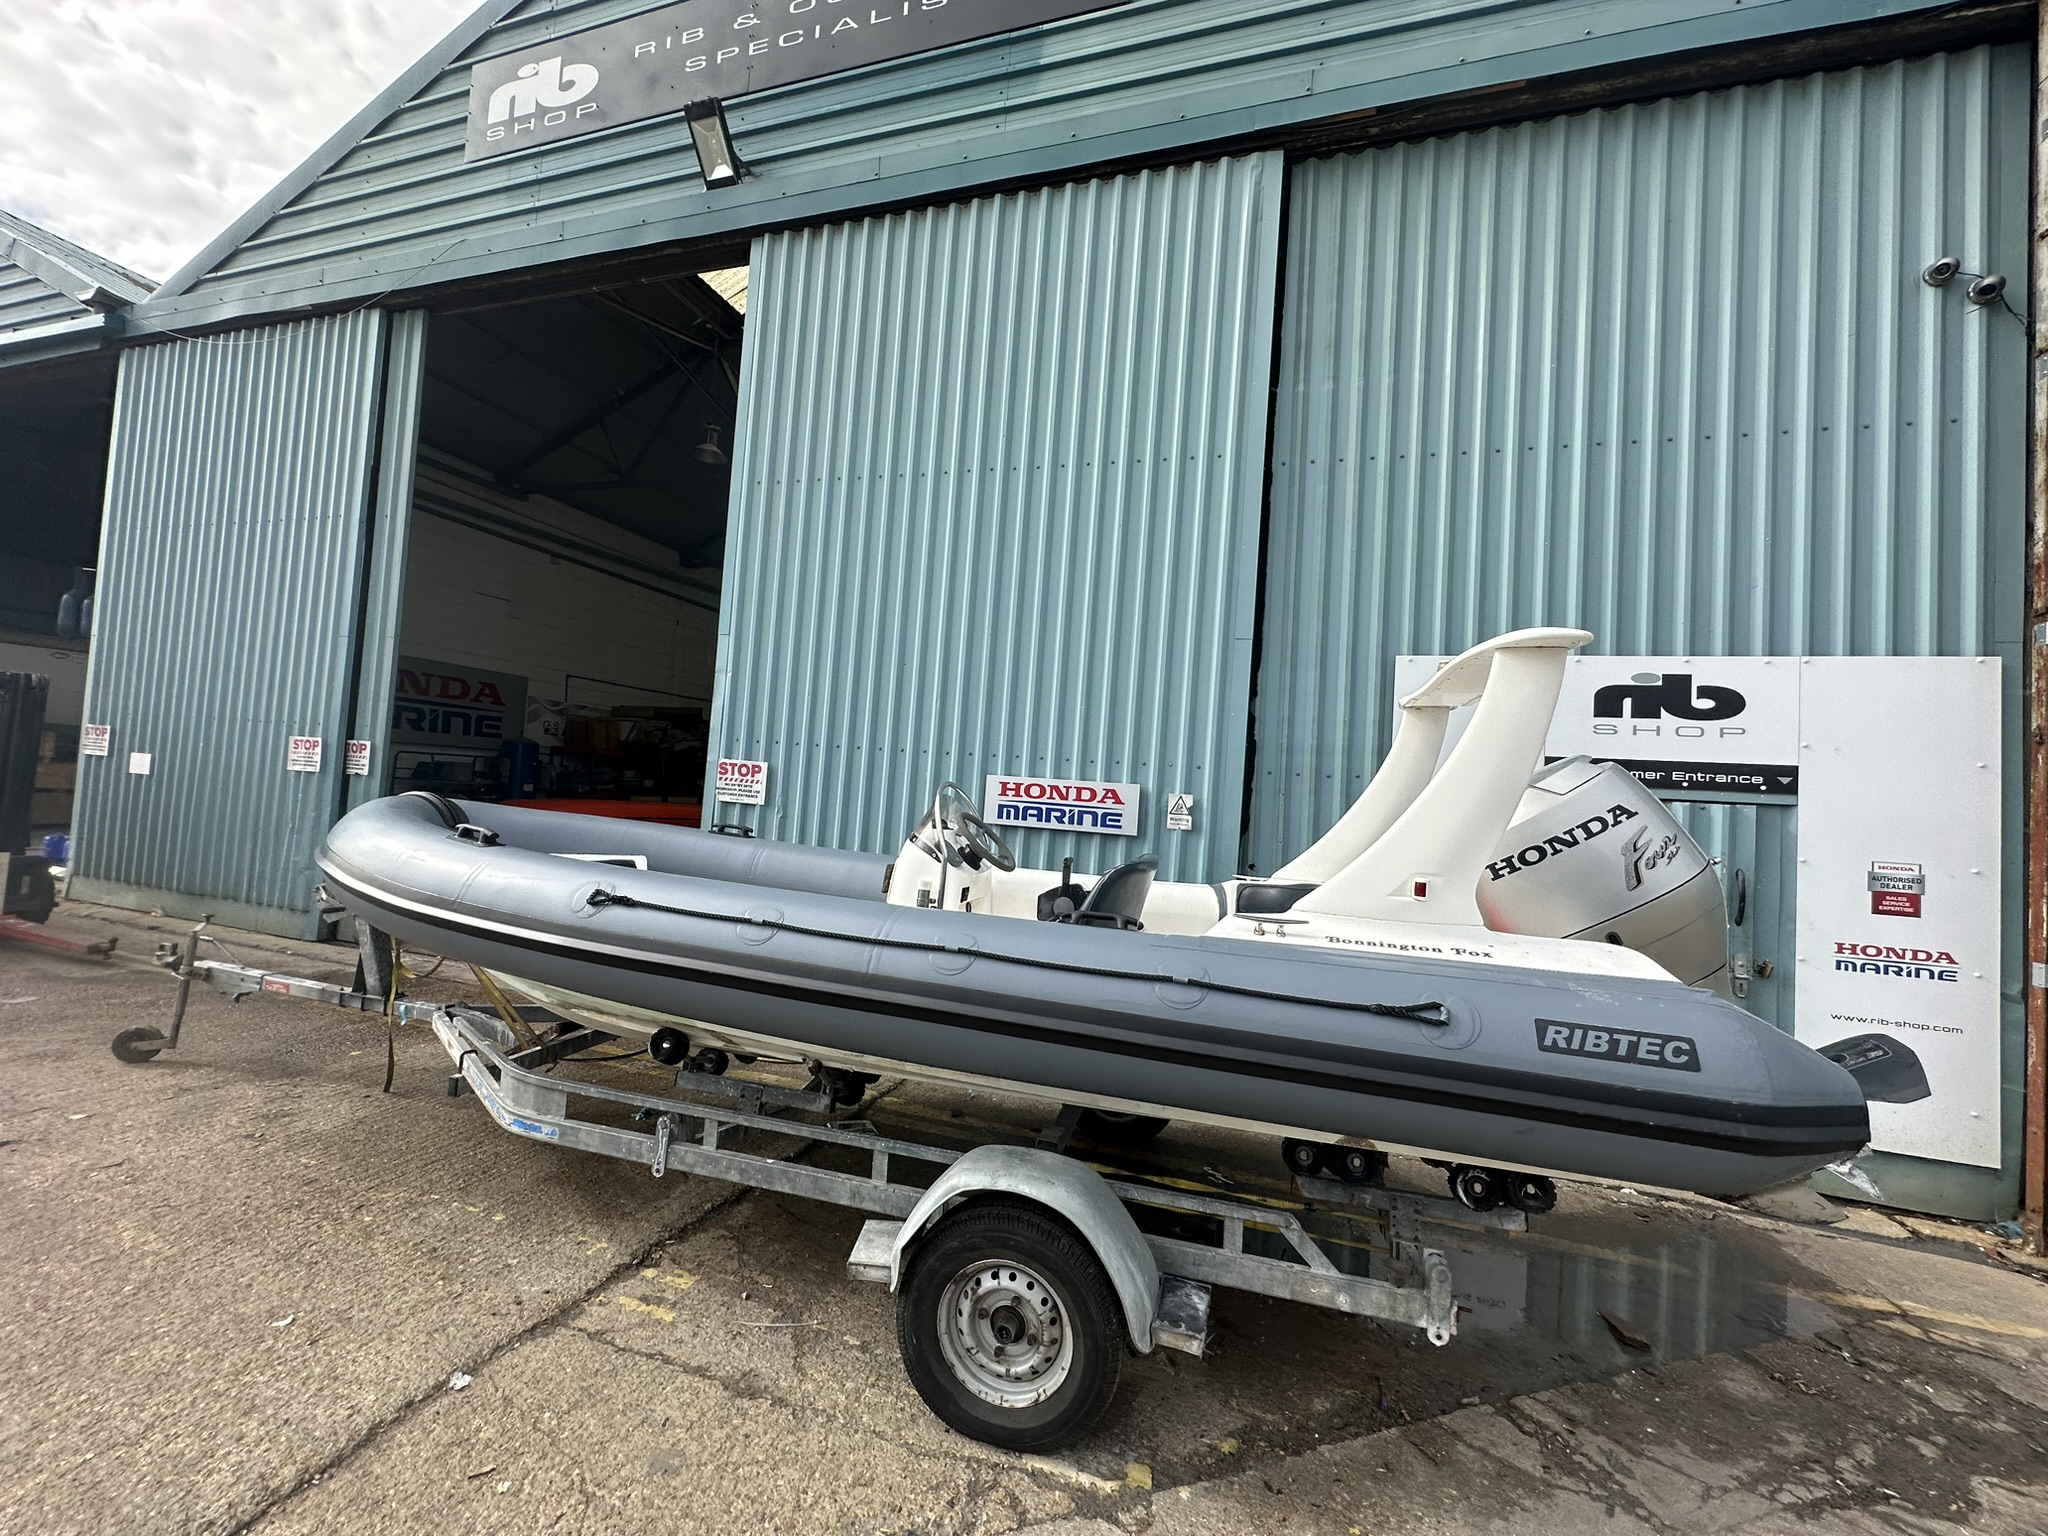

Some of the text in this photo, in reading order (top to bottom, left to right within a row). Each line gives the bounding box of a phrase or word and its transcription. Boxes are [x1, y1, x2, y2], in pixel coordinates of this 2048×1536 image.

[634, 27, 705, 58] RIB
[732, 13, 761, 30] &
[485, 102, 598, 141] SHOP
[396, 668, 506, 706] NDA
[1593, 672, 1747, 722] rib
[85, 726, 107, 737] STOP
[393, 703, 504, 739] RINE
[1592, 723, 1747, 739] SHOP
[293, 739, 319, 750] STOP
[346, 743, 367, 754] TOP
[718, 762, 762, 778] STOP
[1671, 771, 1764, 785] Entrance
[997, 781, 1126, 806] HONDA
[996, 803, 1123, 829] MARINE
[1484, 803, 1640, 882] HONDA
[1871, 875, 1923, 885] AUTHORISED
[1877, 865, 1916, 873] HONDA
[1880, 882, 1914, 891] DEALER
[1878, 905, 1915, 913] EXPERTISE
[1325, 936, 1495, 959] Bonnington Fox
[1834, 942, 1960, 966] HONDA
[1835, 959, 1958, 983] MARINE
[1830, 1013, 1964, 1035] www.rib-shop.com
[1543, 1025, 1691, 1064] RIBTEC
